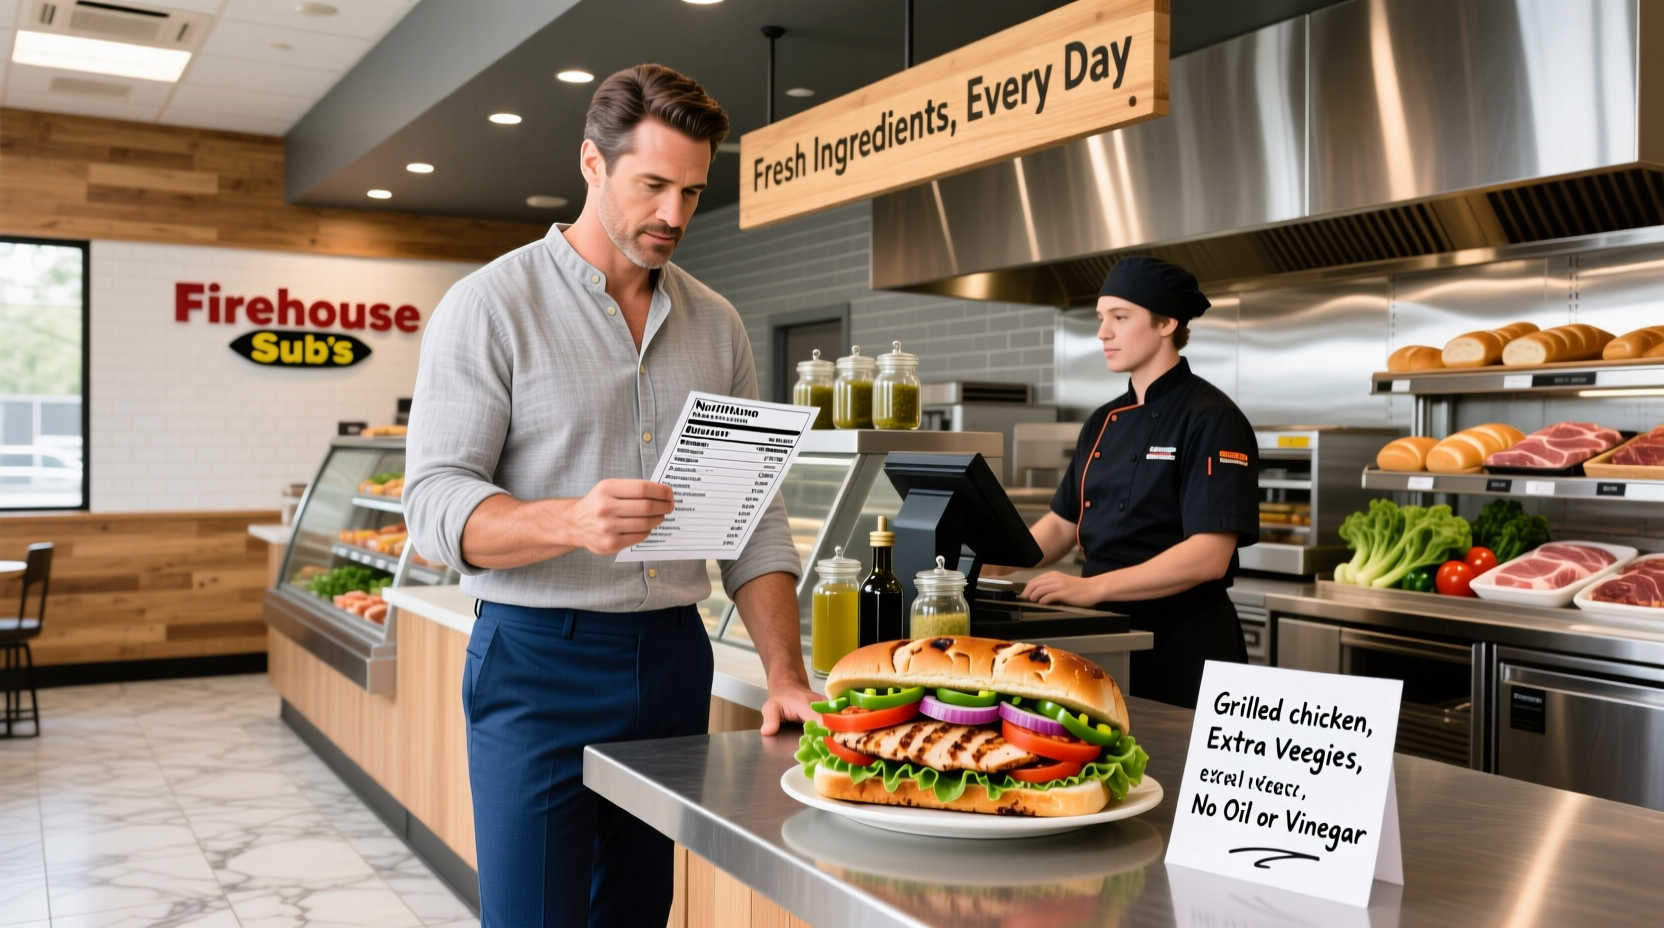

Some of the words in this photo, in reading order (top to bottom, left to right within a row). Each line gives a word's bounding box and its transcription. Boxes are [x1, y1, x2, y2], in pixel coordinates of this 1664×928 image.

[753, 142, 807, 193] Fresh
[813, 98, 957, 176] Ingredients,
[966, 63, 1053, 123] Every
[1064, 35, 1133, 91] Day
[175, 282, 421, 334] Firehouse
[250, 331, 354, 365] Sub's
[1213, 691, 1284, 722] Grilled
[1289, 701, 1373, 738] chicken,
[1207, 726, 1266, 757] Extra
[1276, 737, 1363, 776] Veegies,
[1191, 793, 1217, 817] No
[1223, 798, 1253, 825] Oil
[1256, 811, 1279, 829] or
[1286, 809, 1367, 853] Vinegar
